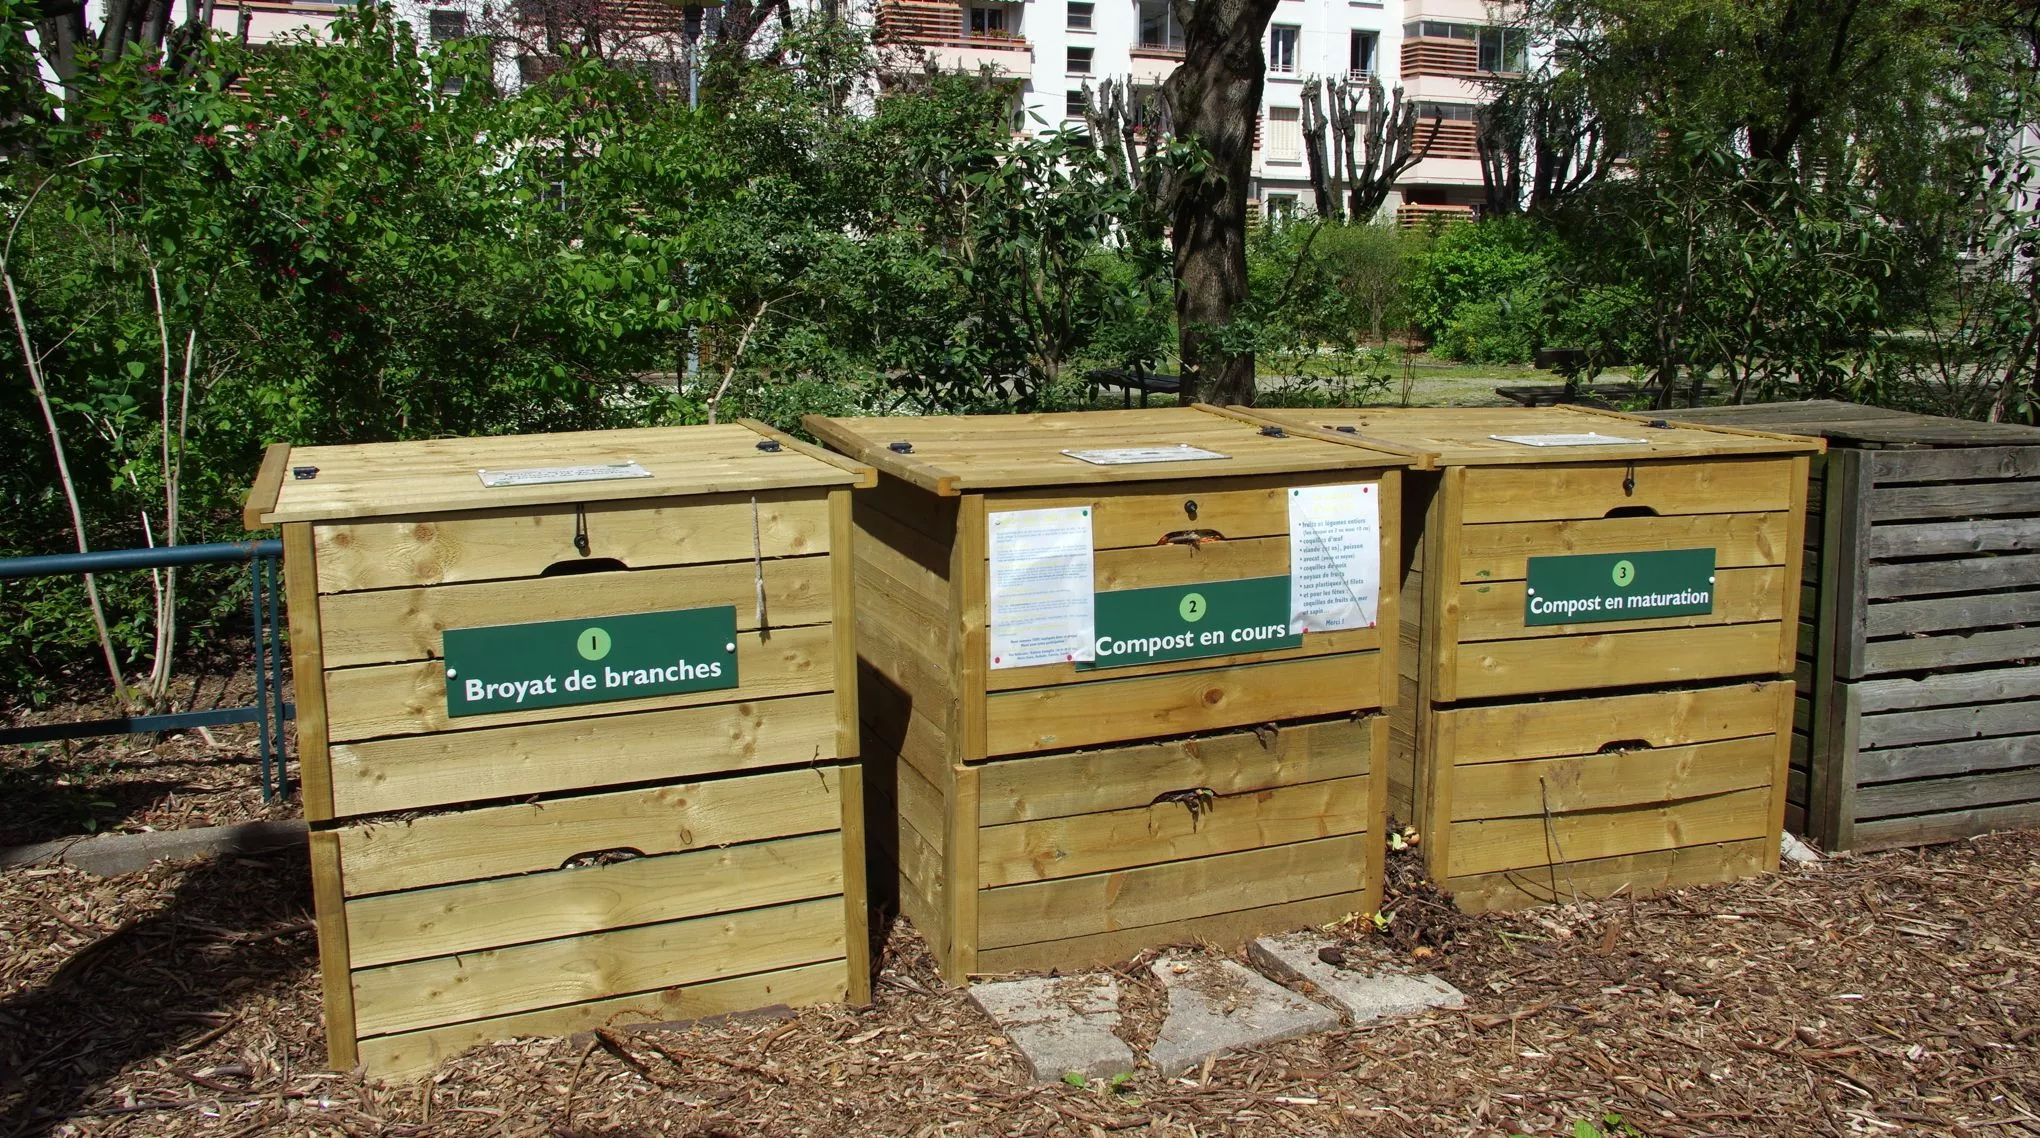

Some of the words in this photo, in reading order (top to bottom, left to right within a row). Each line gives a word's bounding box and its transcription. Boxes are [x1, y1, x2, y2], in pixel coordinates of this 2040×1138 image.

[1619, 566, 1627, 579] 3
[1189, 600, 1197, 613] 2
[1530, 596, 1601, 617] Compost
[1605, 596, 1623, 610] en
[1627, 588, 1709, 608] maturation
[1325, 618, 1341, 626] Merci
[592, 635, 597, 651] 1
[1095, 630, 1195, 657] Compost
[1200, 630, 1225, 646] en
[1231, 623, 1286, 642] cours
[465, 674, 557, 703] Broyat
[564, 669, 597, 692] de
[604, 659, 722, 688] branches
